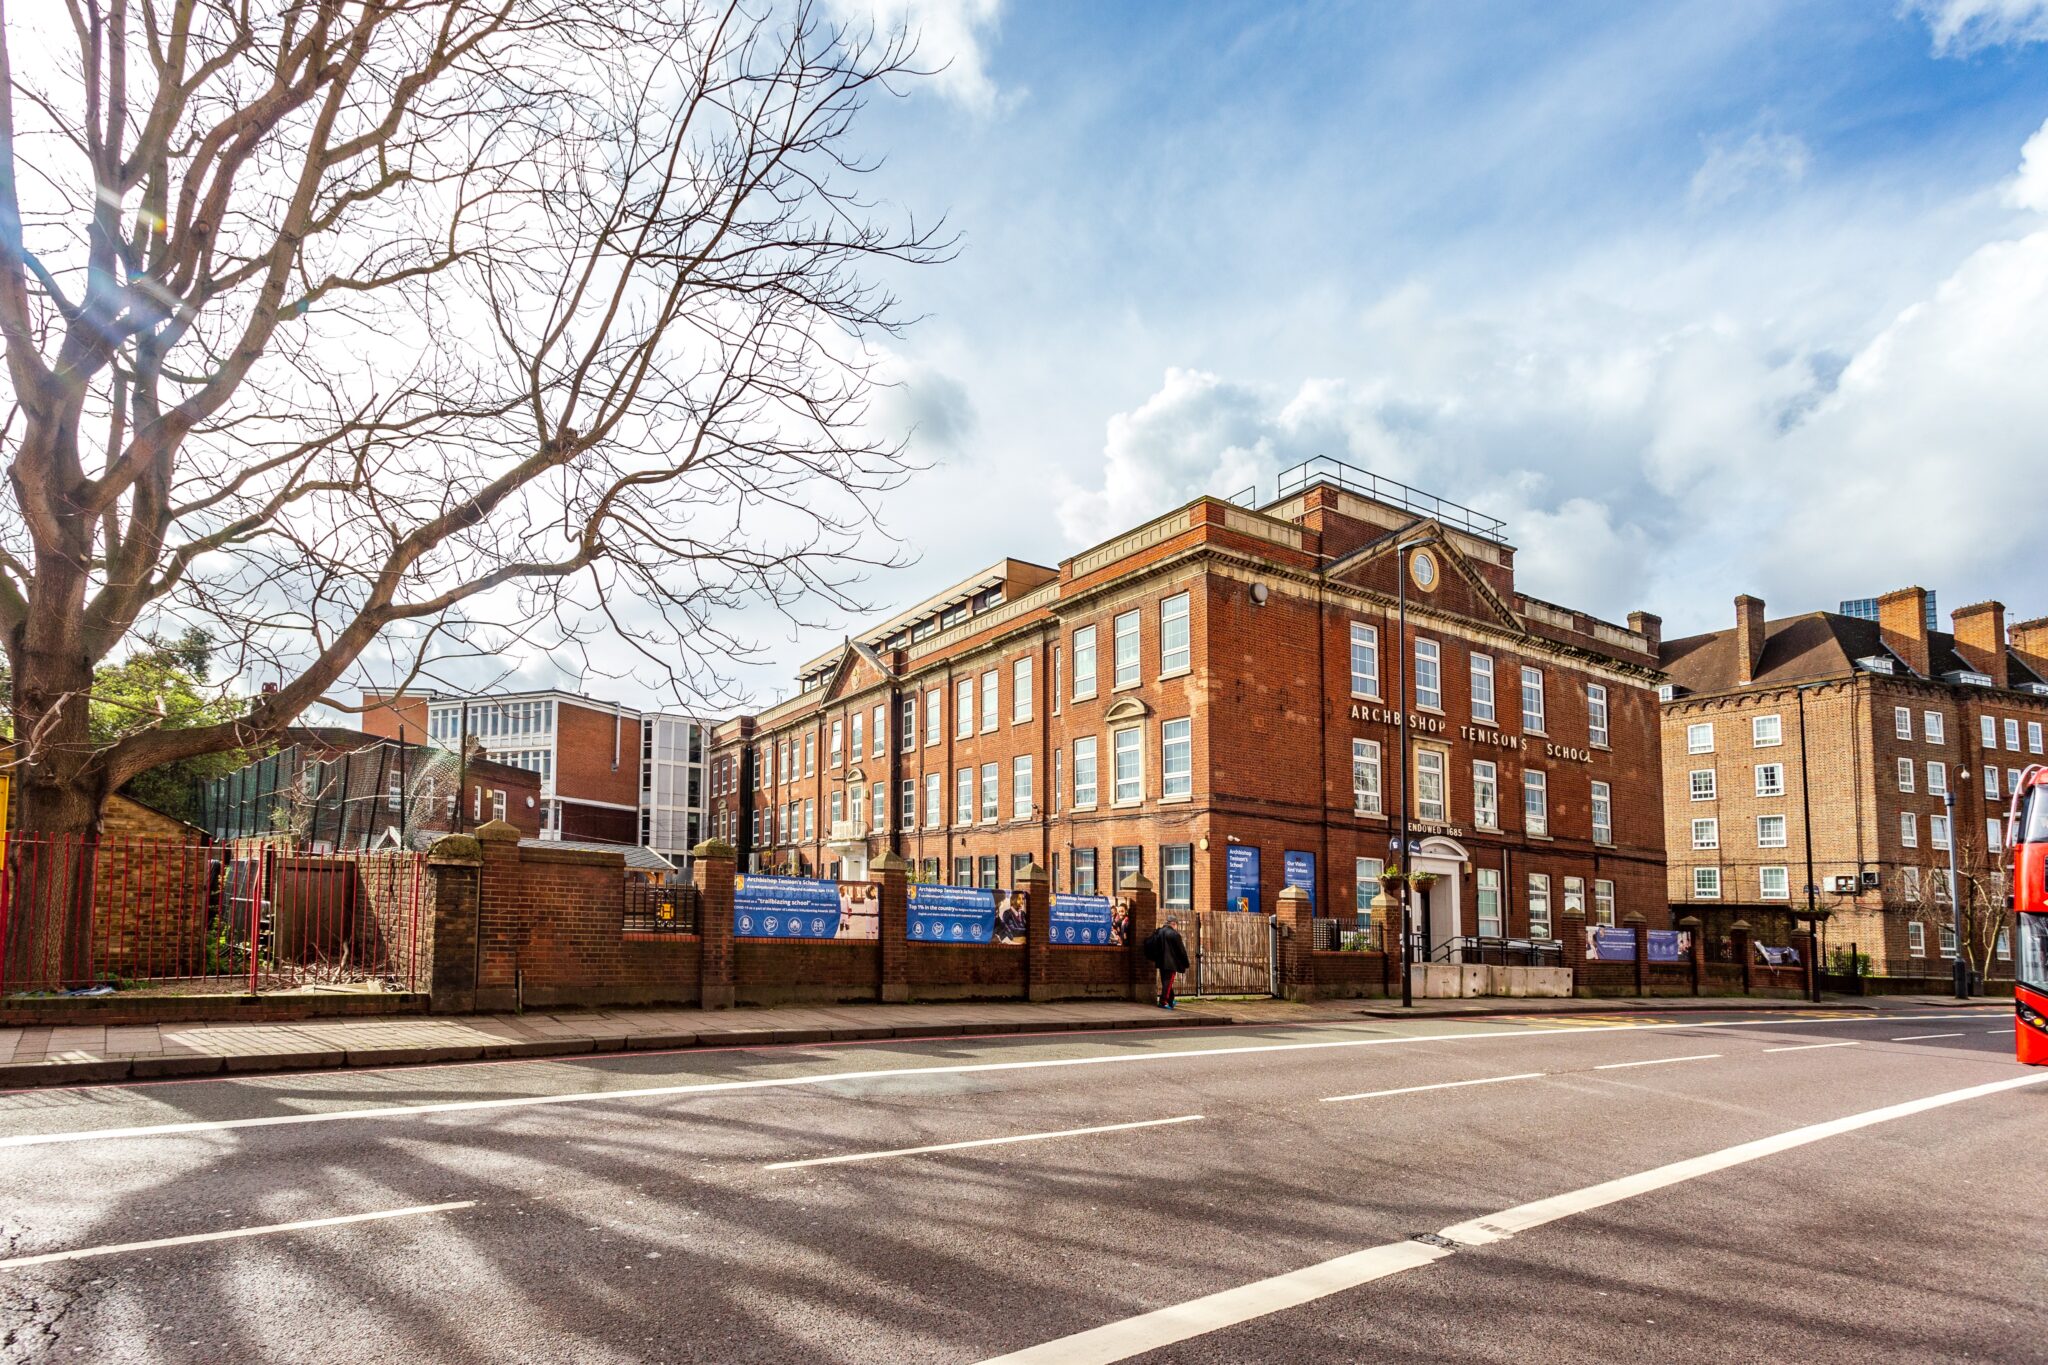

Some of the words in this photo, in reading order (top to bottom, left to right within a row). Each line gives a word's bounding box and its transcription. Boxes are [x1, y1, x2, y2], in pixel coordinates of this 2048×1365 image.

[1351, 704, 1446, 732] ARCHBSHOP
[1408, 822, 1442, 834] ENDOWED
[1446, 827, 1463, 837] 1685
[1229, 849, 1252, 857] Archbishop
[746, 876, 778, 884] Archbishop
[918, 886, 944, 894] Archbishop
